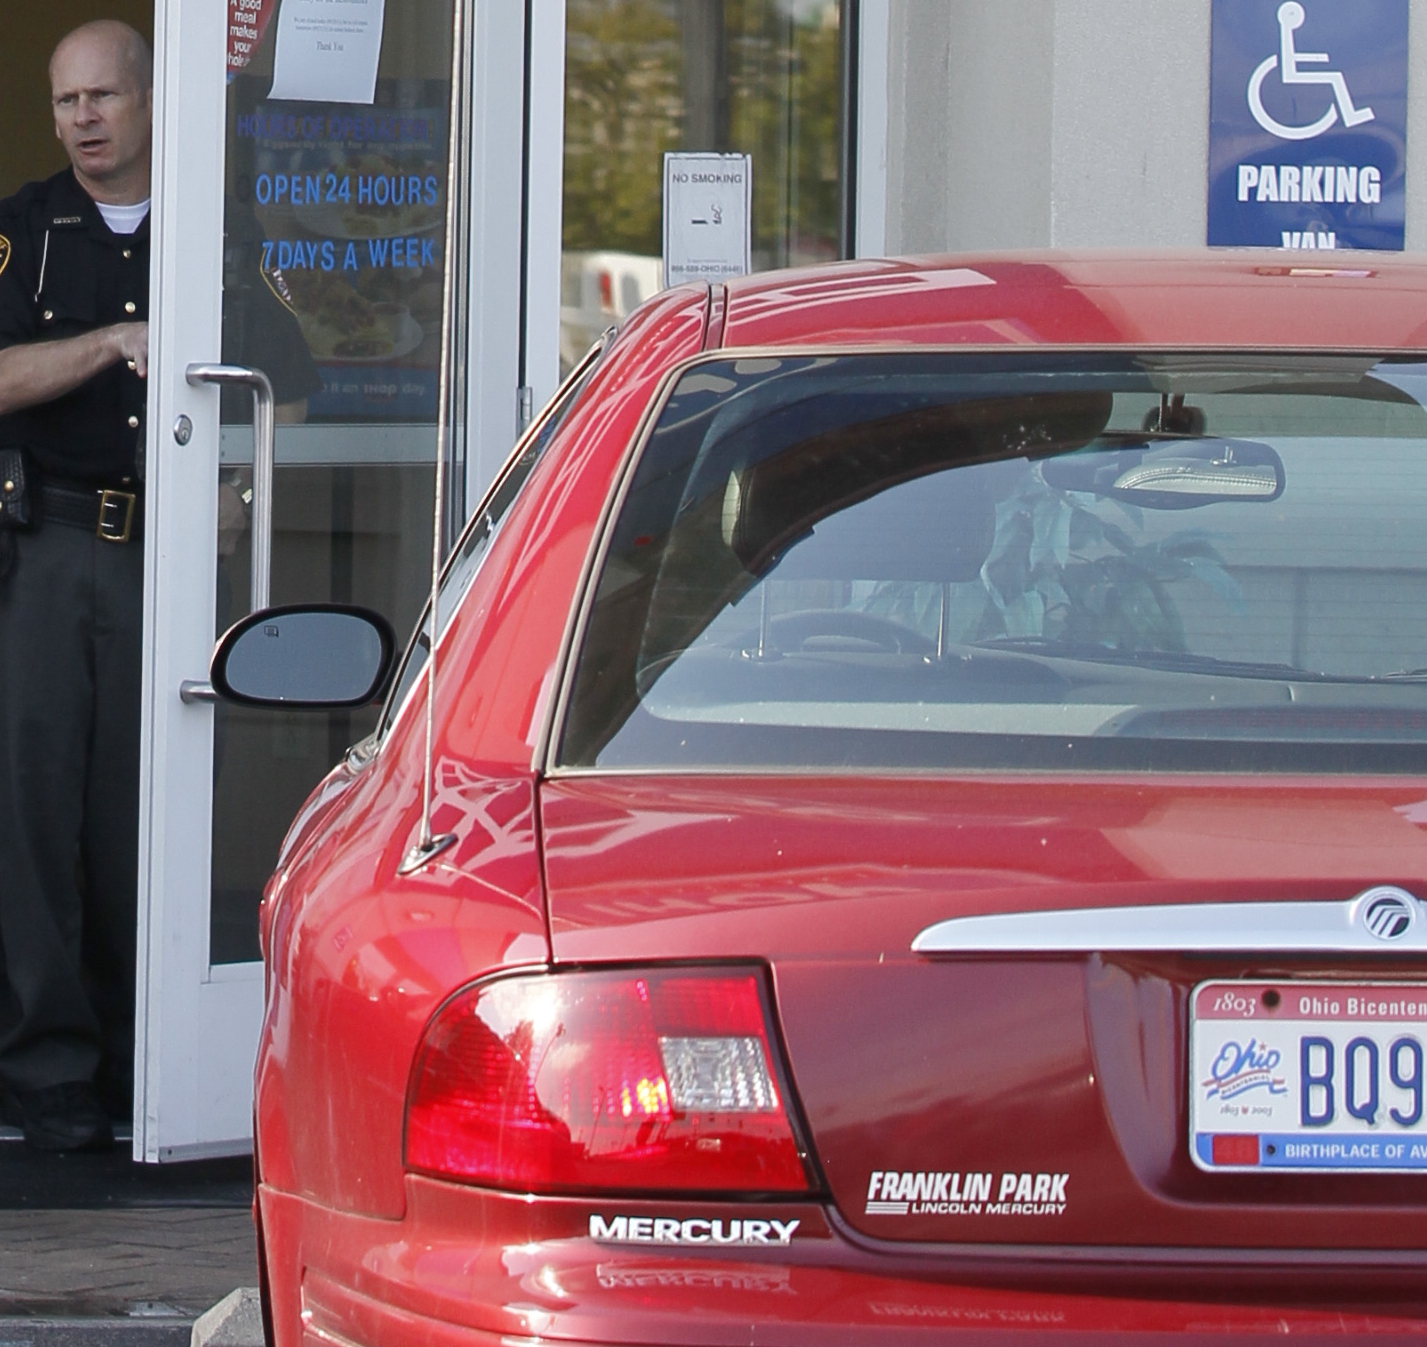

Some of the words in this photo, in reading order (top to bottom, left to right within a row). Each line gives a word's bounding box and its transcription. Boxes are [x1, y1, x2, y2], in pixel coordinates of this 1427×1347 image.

[234, 11, 257, 24] meal
[229, 25, 258, 40] makes
[234, 41, 252, 54] your
[237, 114, 296, 139] HOURS
[302, 115, 323, 140] OF
[256, 173, 321, 205] OPEN
[325, 172, 350, 203] 24
[358, 175, 438, 205] HOURS
[673, 174, 688, 184] NO
[691, 174, 742, 184] SMOKING
[1238, 165, 1382, 204] PARKING
[263, 241, 275, 272] 7
[278, 241, 335, 271] DAYS
[343, 242, 358, 271] A
[368, 238, 435, 269] WEEK
[1213, 991, 1256, 1017] 1803
[1299, 996, 1340, 1016] Ohio
[1347, 997, 1427, 1016] Bicenten
[1211, 1038, 1281, 1081] Ohio
[1300, 1036, 1424, 1125] BQ9
[1285, 1143, 1381, 1158] BIRTHPLACE
[1384, 1144, 1405, 1158] OF
[867, 1171, 993, 1201] FRANKLIN
[998, 1173, 1070, 1202] PARK
[911, 1203, 982, 1215] LINCOLN
[984, 1203, 1067, 1216] MERCURY
[589, 1214, 800, 1244] MERCURY
